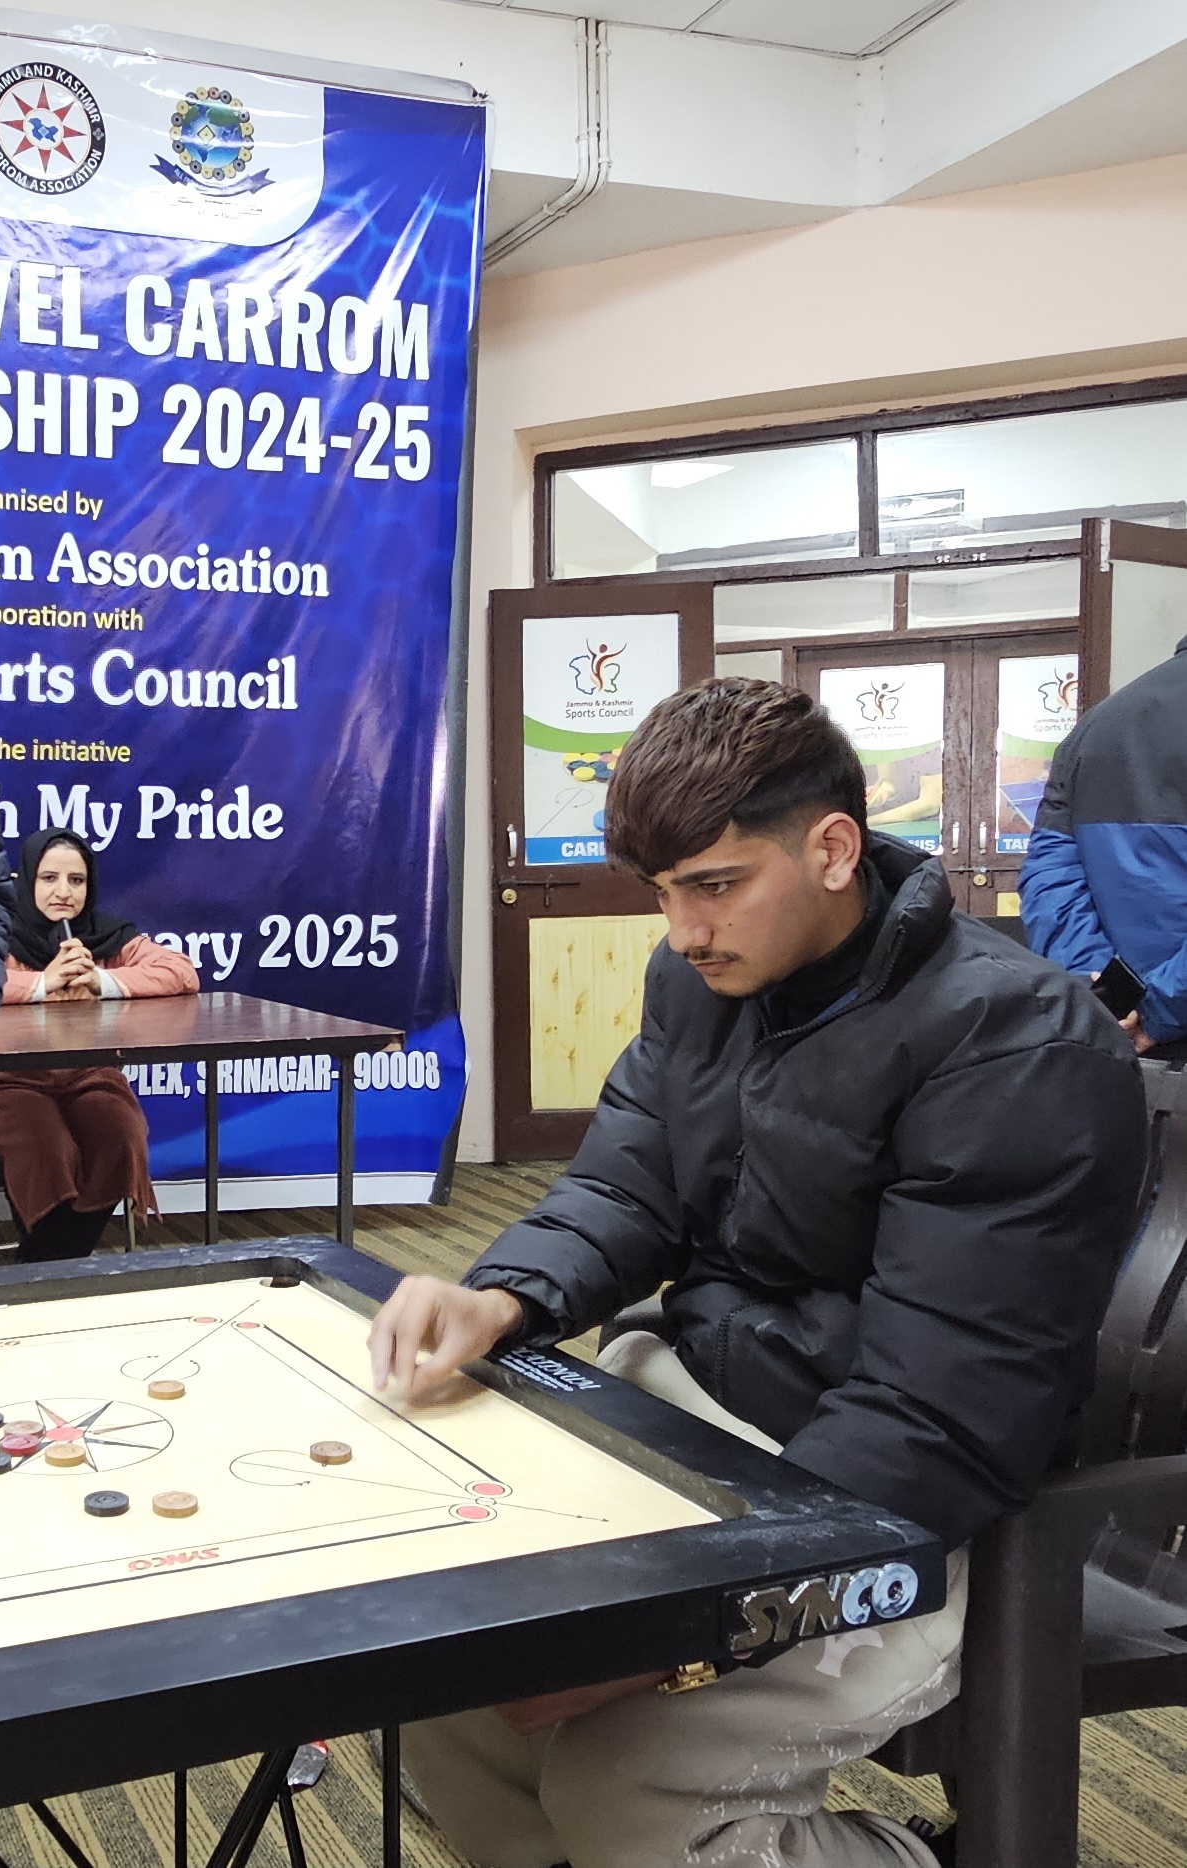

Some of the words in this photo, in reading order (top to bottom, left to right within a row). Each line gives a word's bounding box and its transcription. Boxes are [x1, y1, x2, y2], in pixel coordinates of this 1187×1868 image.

[24, 64, 54, 78] AND
[55, 69, 101, 124] KASHMIR
[29, 148, 103, 193] ASSOCIATION
[125, 274, 430, 381] CARROM
[162, 383, 431, 482] 2024-25
[75, 491, 104, 520] by
[47, 532, 329, 598] Association
[93, 607, 144, 631] with
[91, 648, 298, 710] Council
[565, 709, 595, 719] Sports
[599, 708, 634, 717] Council
[32, 738, 131, 763] initiative
[37, 784, 122, 852] My
[137, 784, 284, 840] Pride
[258, 913, 399, 968] 2025
[353, 1051, 441, 1091] 90008
[128, 1547, 220, 1571] SYNCO
[730, 1562, 918, 1652] SYNCO
